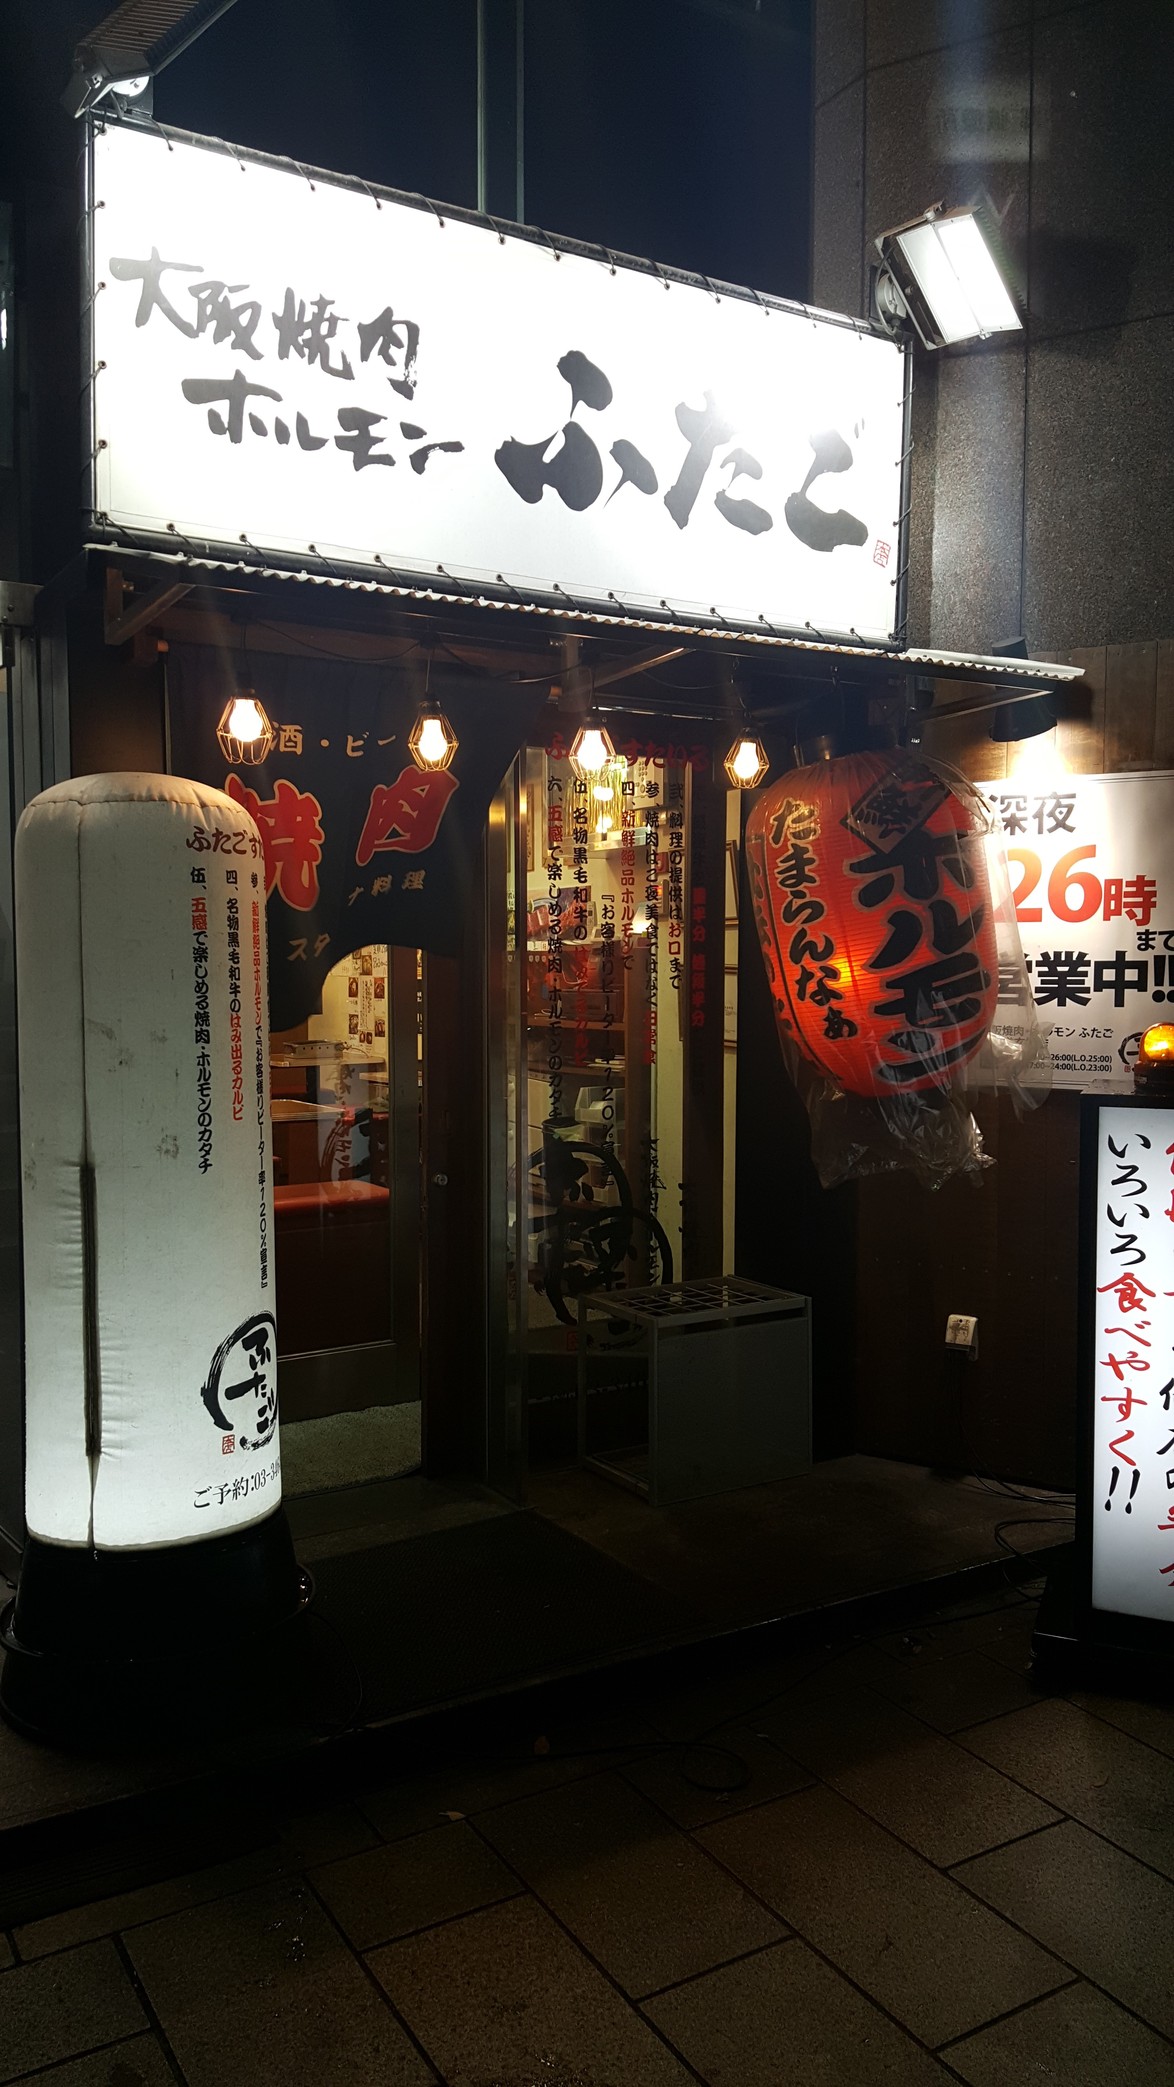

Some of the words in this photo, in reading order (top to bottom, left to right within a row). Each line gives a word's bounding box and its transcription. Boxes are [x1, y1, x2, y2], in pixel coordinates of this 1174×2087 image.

[108, 246, 420, 400] 大阪焼肉
[181, 369, 465, 475] ホルモン
[494, 349, 868, 553] ふたご
[988, 792, 1077, 836] 深夜
[1079, 1027, 1114, 1039] ふたご
[1096, 1133, 1157, 1515] いろいろ食べやすく!!
